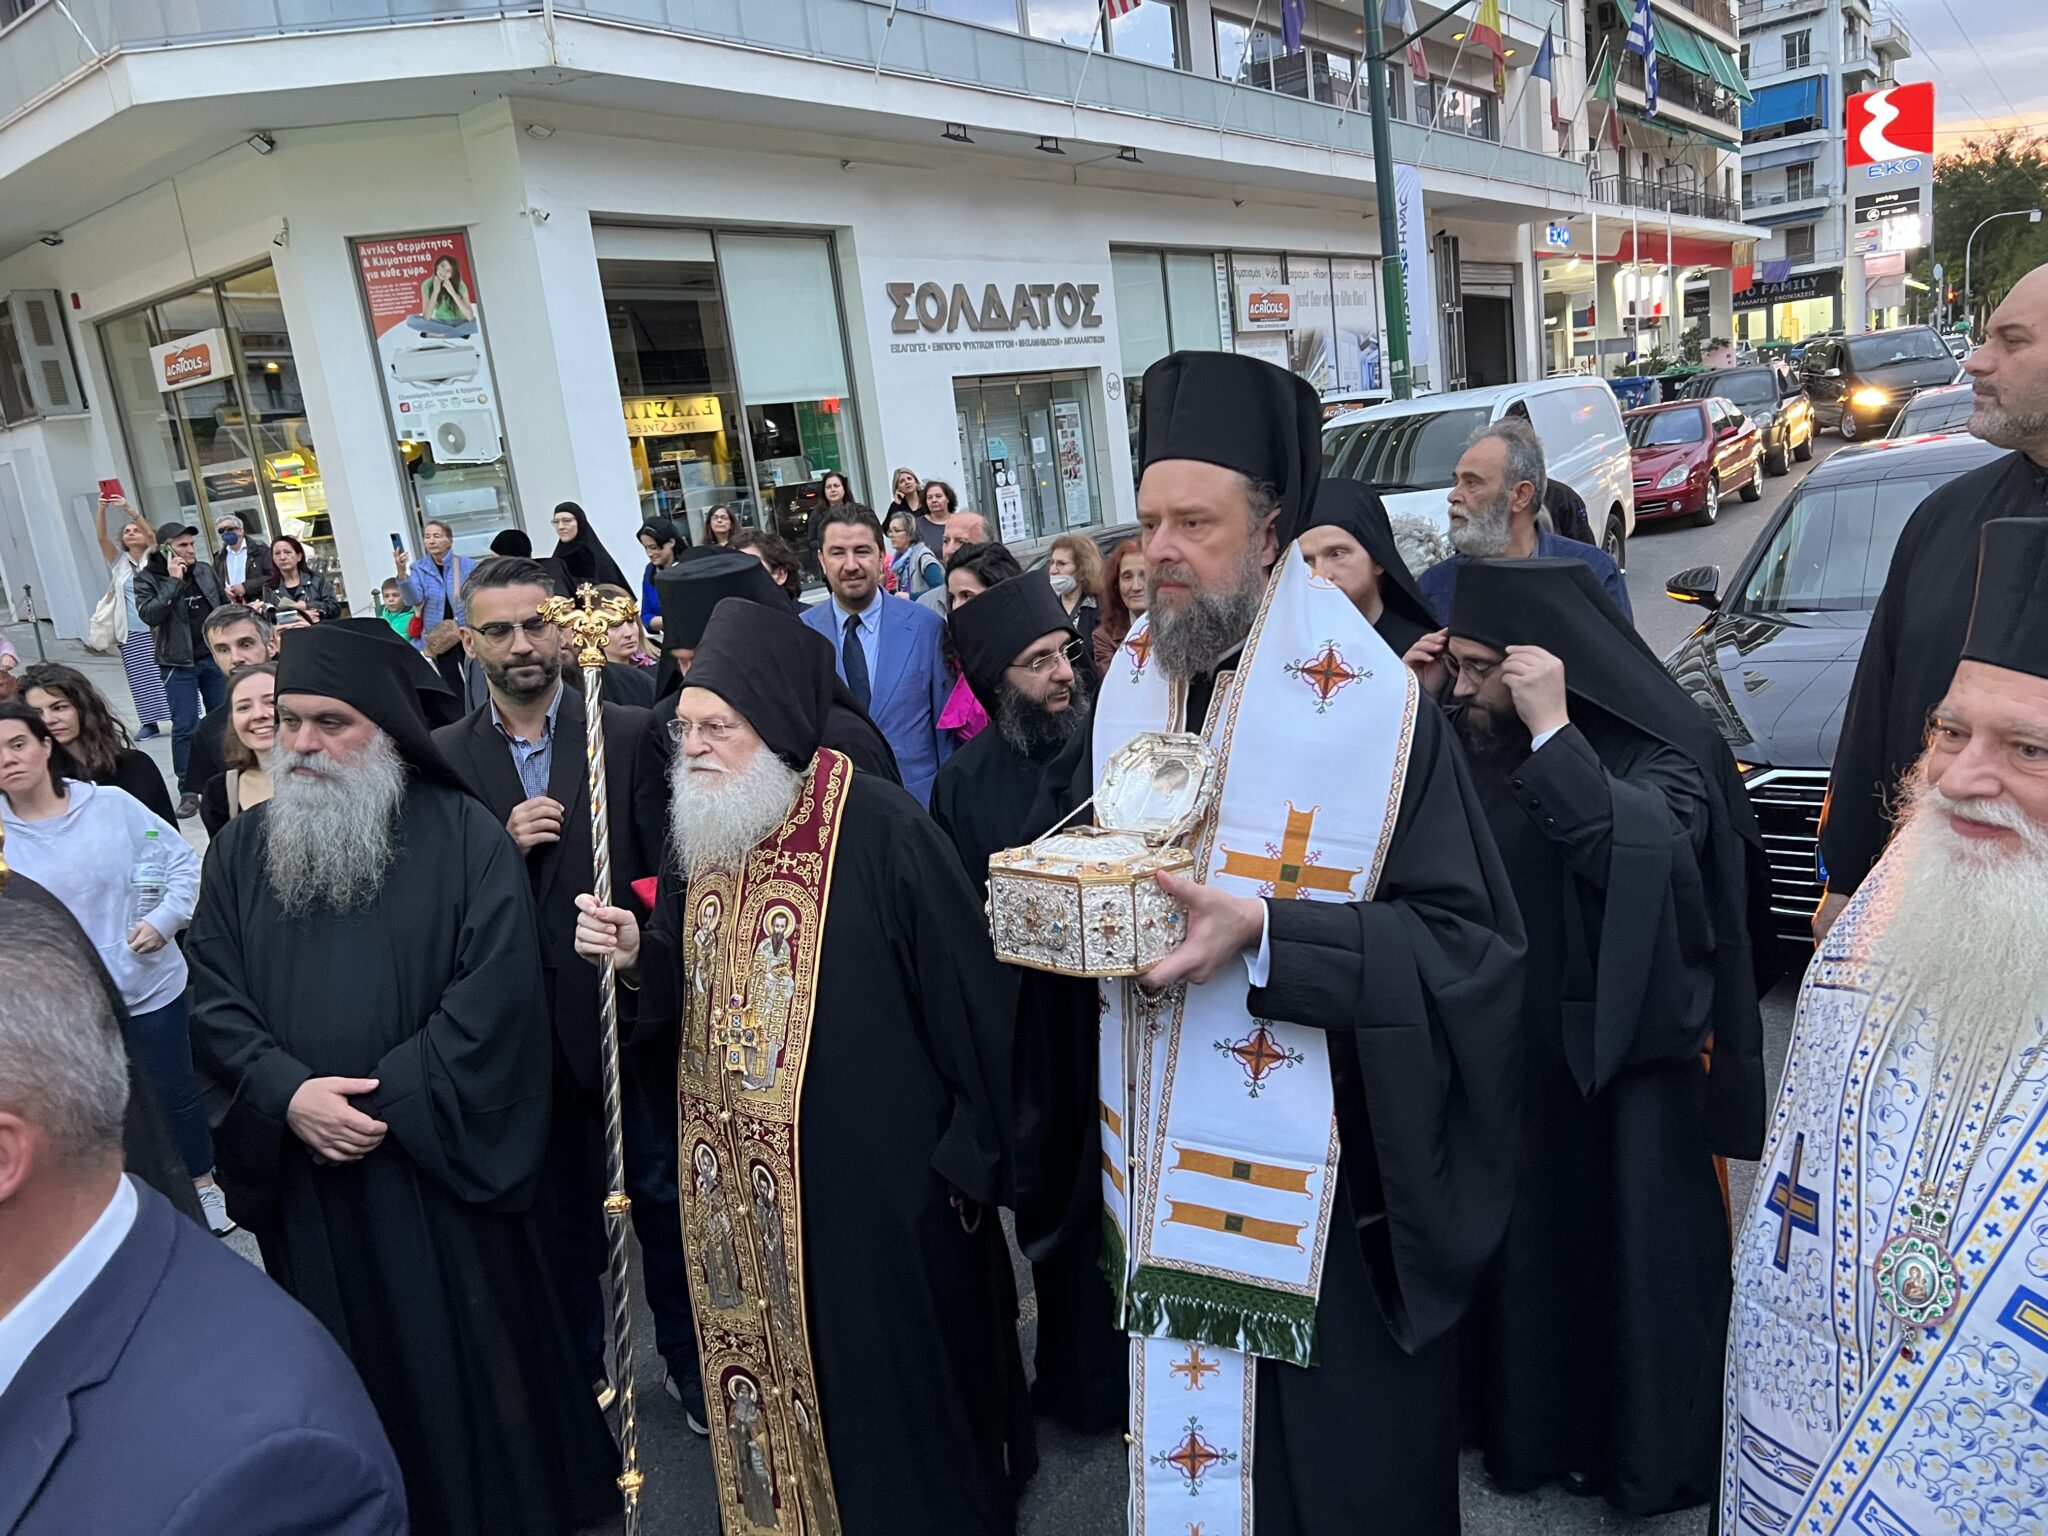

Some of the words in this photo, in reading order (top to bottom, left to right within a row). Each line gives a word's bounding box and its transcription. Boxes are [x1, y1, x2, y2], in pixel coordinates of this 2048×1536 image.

[1868, 158, 1921, 179] EKO
[1875, 194, 1899, 203] parking
[1398, 191, 1408, 244] HVAC
[1546, 225, 1571, 247] EKO
[360, 245, 396, 256] Αντλίες
[396, 239, 454, 252] Θερμότητας
[363, 258, 370, 268] &
[372, 253, 432, 268] Κλιματιστικά
[365, 272, 379, 281] για
[380, 267, 401, 279] κάθε
[1762, 276, 1820, 295] FAMILY
[886, 282, 1102, 333] ΣΟΛΔΑΤΟΣ
[1249, 299, 1284, 315] ACRTOOLS
[890, 343, 928, 353] ΕΙΣΑΓΩΓΕΣ
[931, 341, 962, 352] ΕΜΠΟΡΙΟ
[962, 339, 995, 351] ΨΥΚΤΙΚΩΝ
[994, 339, 1015, 349] ΥΓΡΩΝ
[166, 356, 203, 377] ACRTOOLS
[1107, 381, 1120, 393] 340
